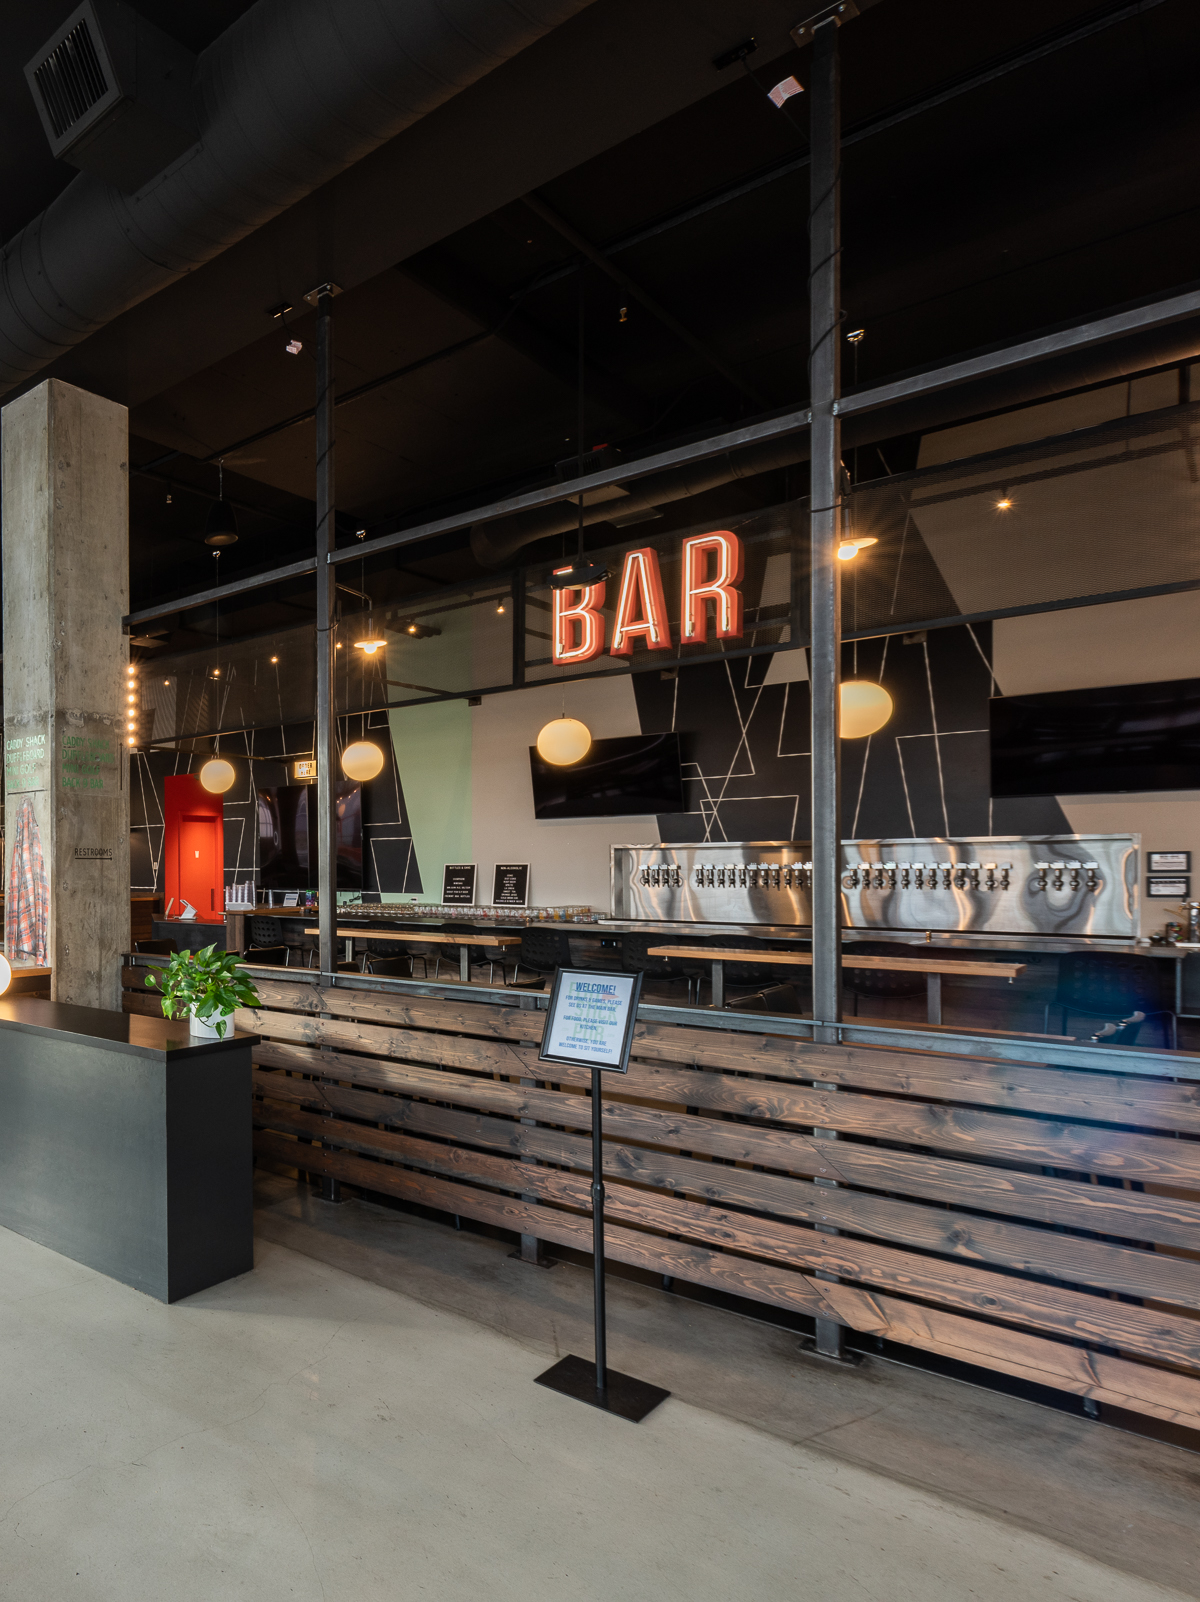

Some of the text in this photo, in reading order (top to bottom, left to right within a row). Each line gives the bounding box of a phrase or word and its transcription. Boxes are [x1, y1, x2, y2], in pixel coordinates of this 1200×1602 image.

[552, 530, 745, 666] BAR
[7, 734, 46, 750] CADDY SHACK
[62, 735, 85, 747] CADDY
[6, 748, 45, 763] DUFFLEBOARD
[6, 763, 36, 776] MINI GOLF
[62, 763, 100, 775] MINI GOLF
[62, 777, 104, 789] BACK 9 BAR
[74, 847, 113, 857] RESTROOMS
[575, 982, 616, 995] WELCOME!
